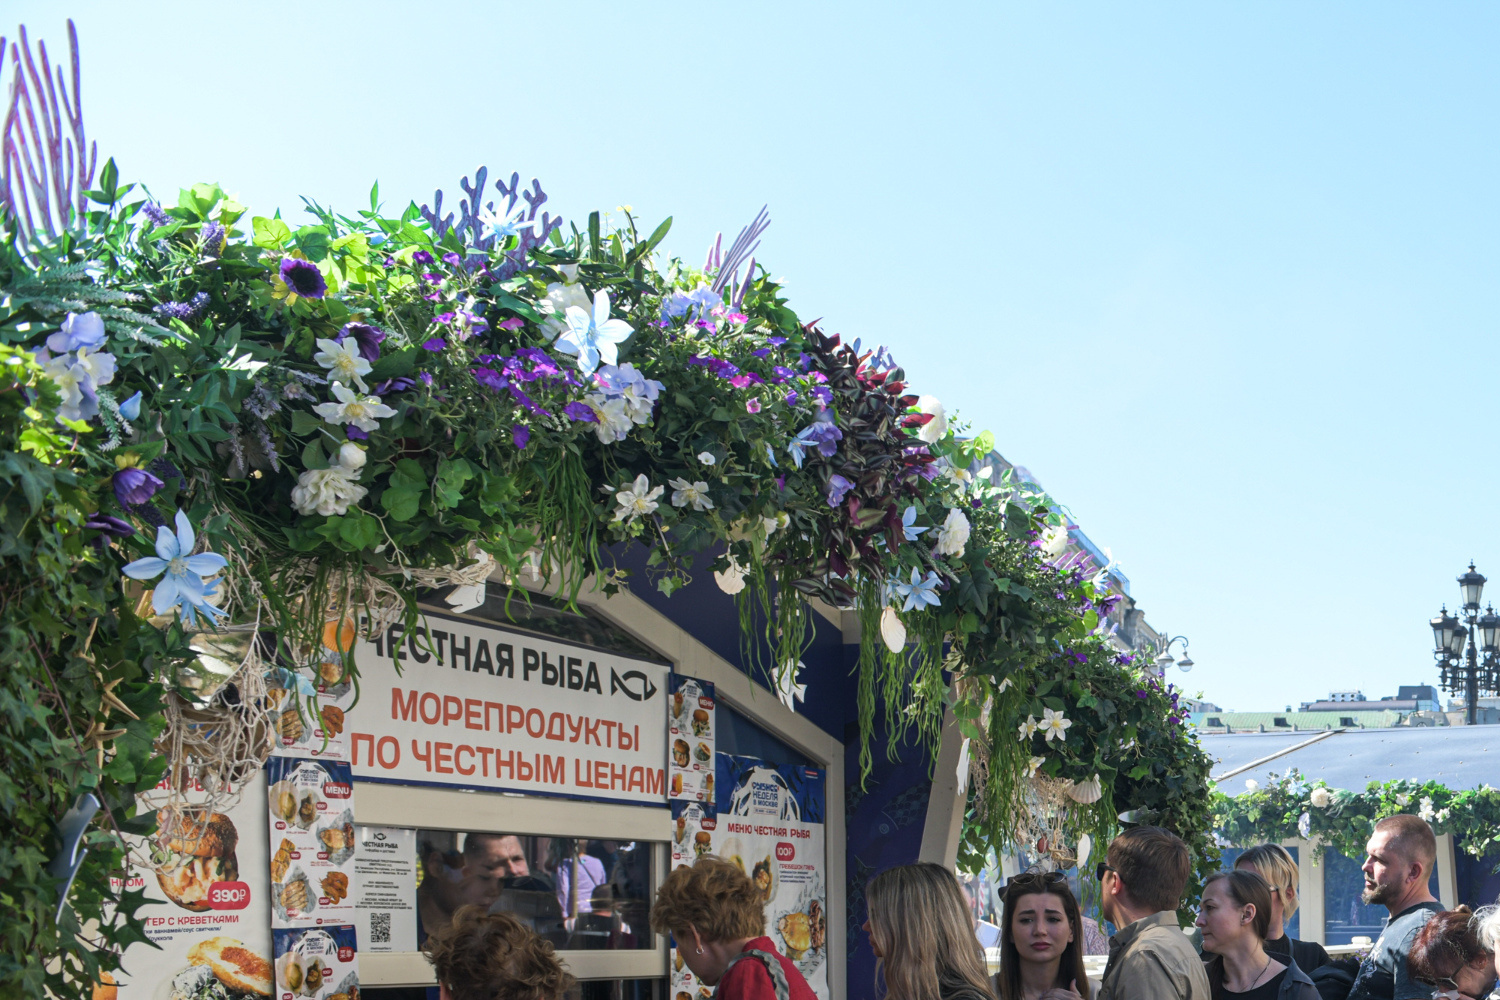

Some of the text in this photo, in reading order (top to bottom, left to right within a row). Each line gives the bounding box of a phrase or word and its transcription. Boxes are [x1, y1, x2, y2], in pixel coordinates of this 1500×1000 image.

[522, 648, 602, 695] РЫБА
[390, 687, 640, 752] МОРЕПРОДУКТЫ
[350, 732, 665, 798] ПО ЧЕСТНЫМ ЦЕНАМ
[325, 786, 350, 795] MENU
[752, 791, 778, 801] НЕДЕЛЯ
[728, 823, 811, 839] МЕНЮ ЧЕСТНАЯ РЫБА
[168, 917, 175, 925] С
[178, 914, 239, 925] КРЕВЕТКАМИ
